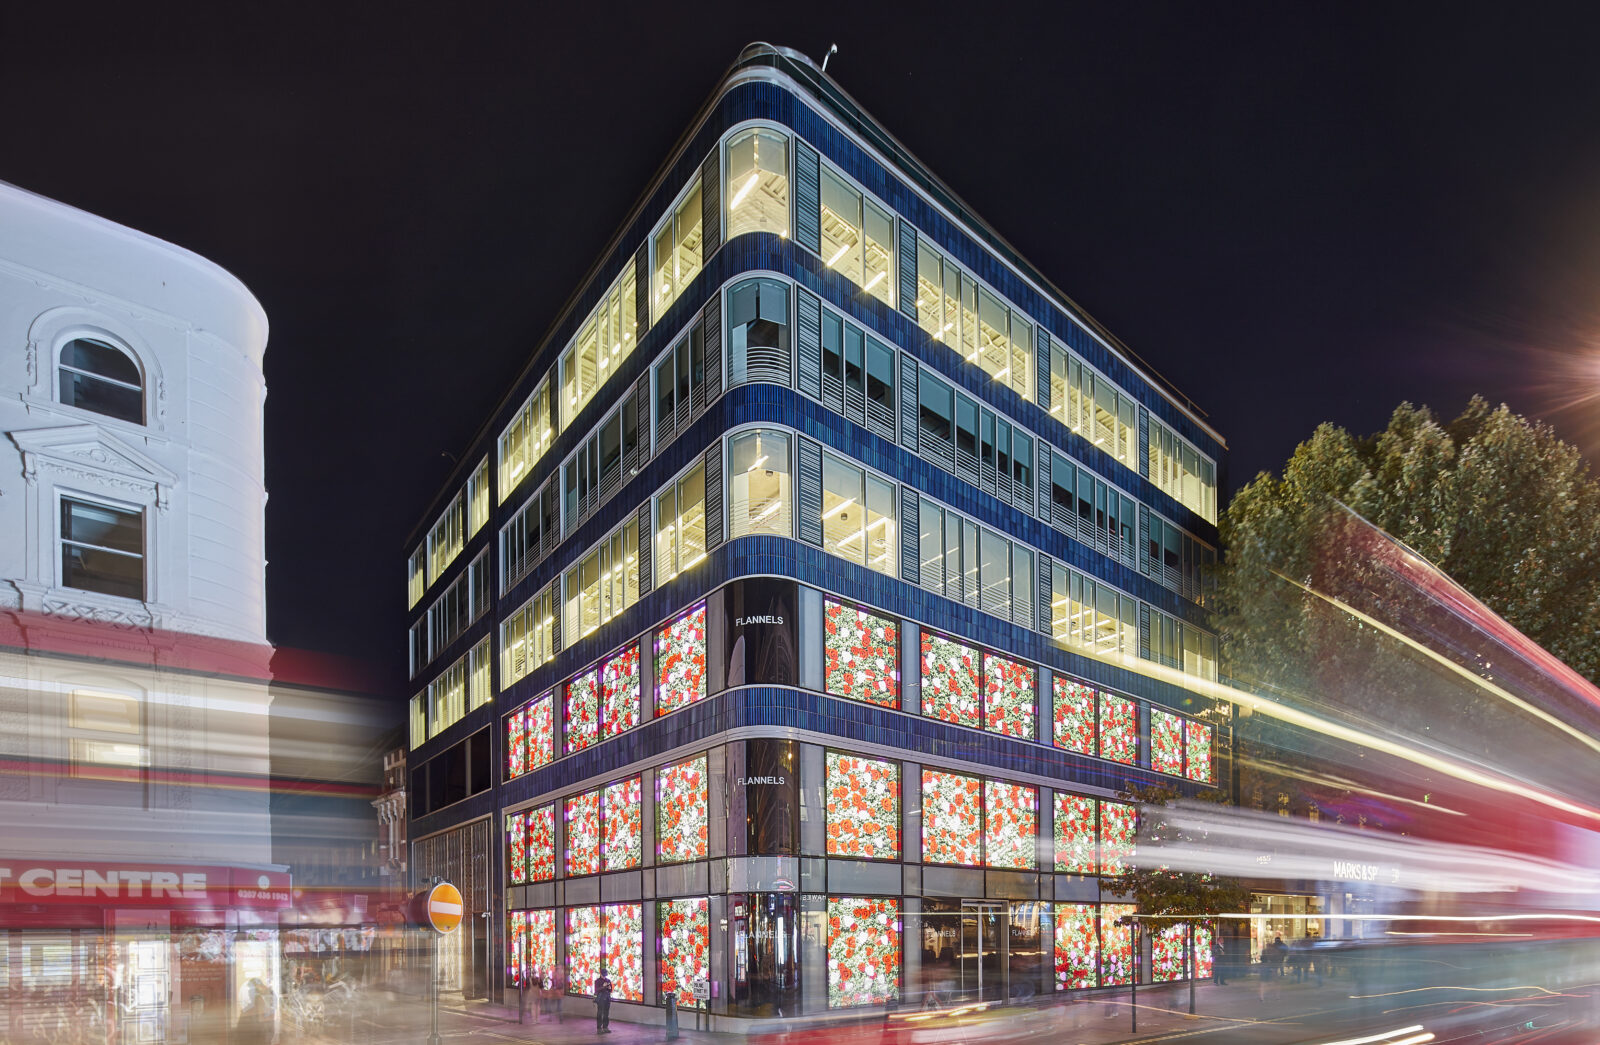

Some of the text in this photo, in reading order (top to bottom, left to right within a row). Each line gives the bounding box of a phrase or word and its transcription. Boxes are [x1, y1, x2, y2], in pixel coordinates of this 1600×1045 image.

[735, 615, 784, 627] FLANNELS
[737, 776, 785, 786] FLANNELS
[1333, 861, 1361, 881] MARKS
[1362, 865, 1367, 881] &
[18, 868, 208, 899] CENTRE
